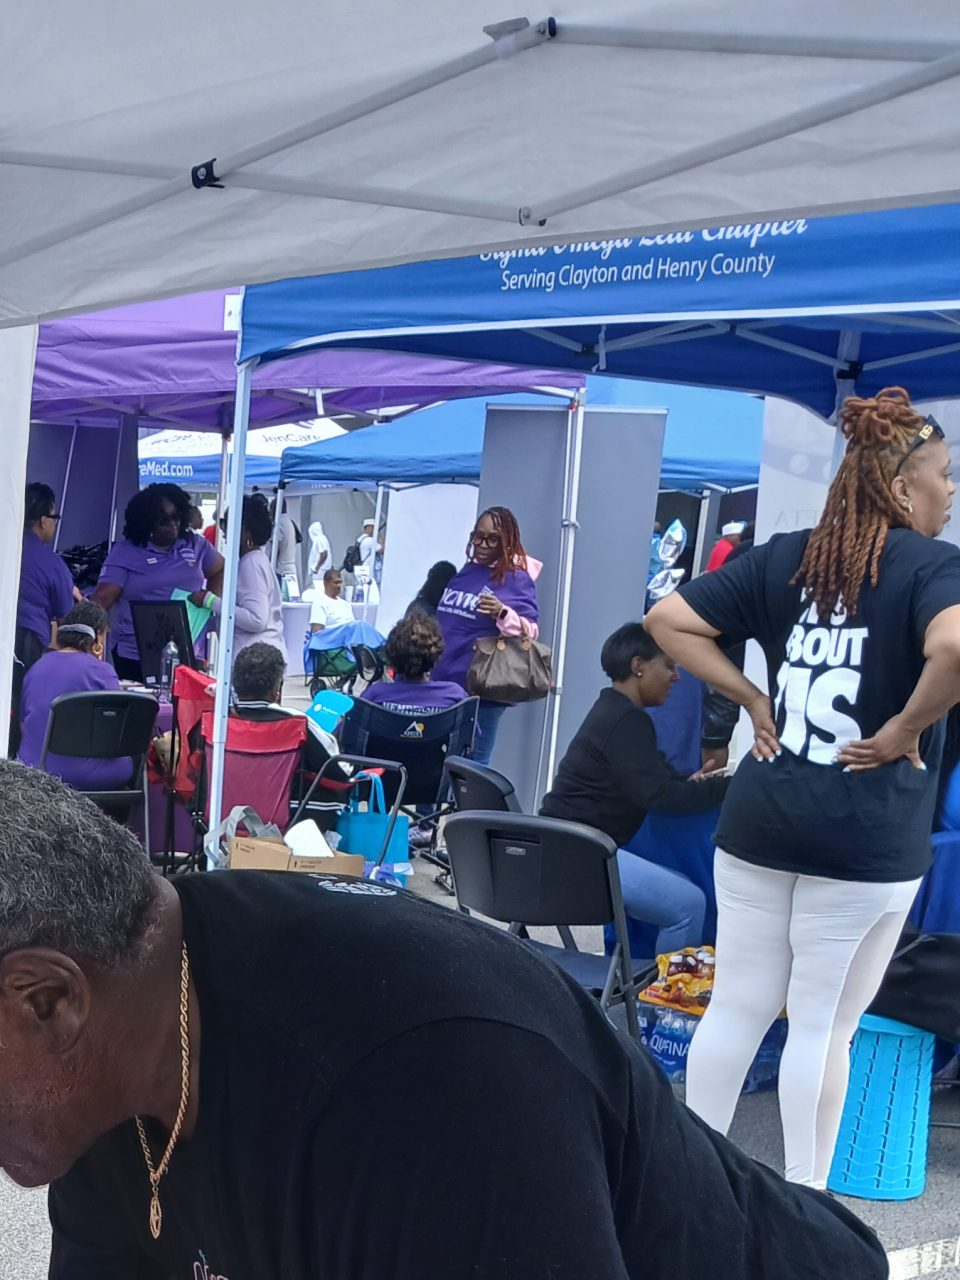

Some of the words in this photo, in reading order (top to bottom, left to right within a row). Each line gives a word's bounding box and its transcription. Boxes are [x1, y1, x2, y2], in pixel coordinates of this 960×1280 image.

[501, 269, 555, 292] Serving
[559, 264, 618, 290] Clayton
[621, 258, 654, 282] and
[657, 256, 707, 282] Henry
[711, 253, 776, 279] County
[138, 462, 194, 478] eMed.com
